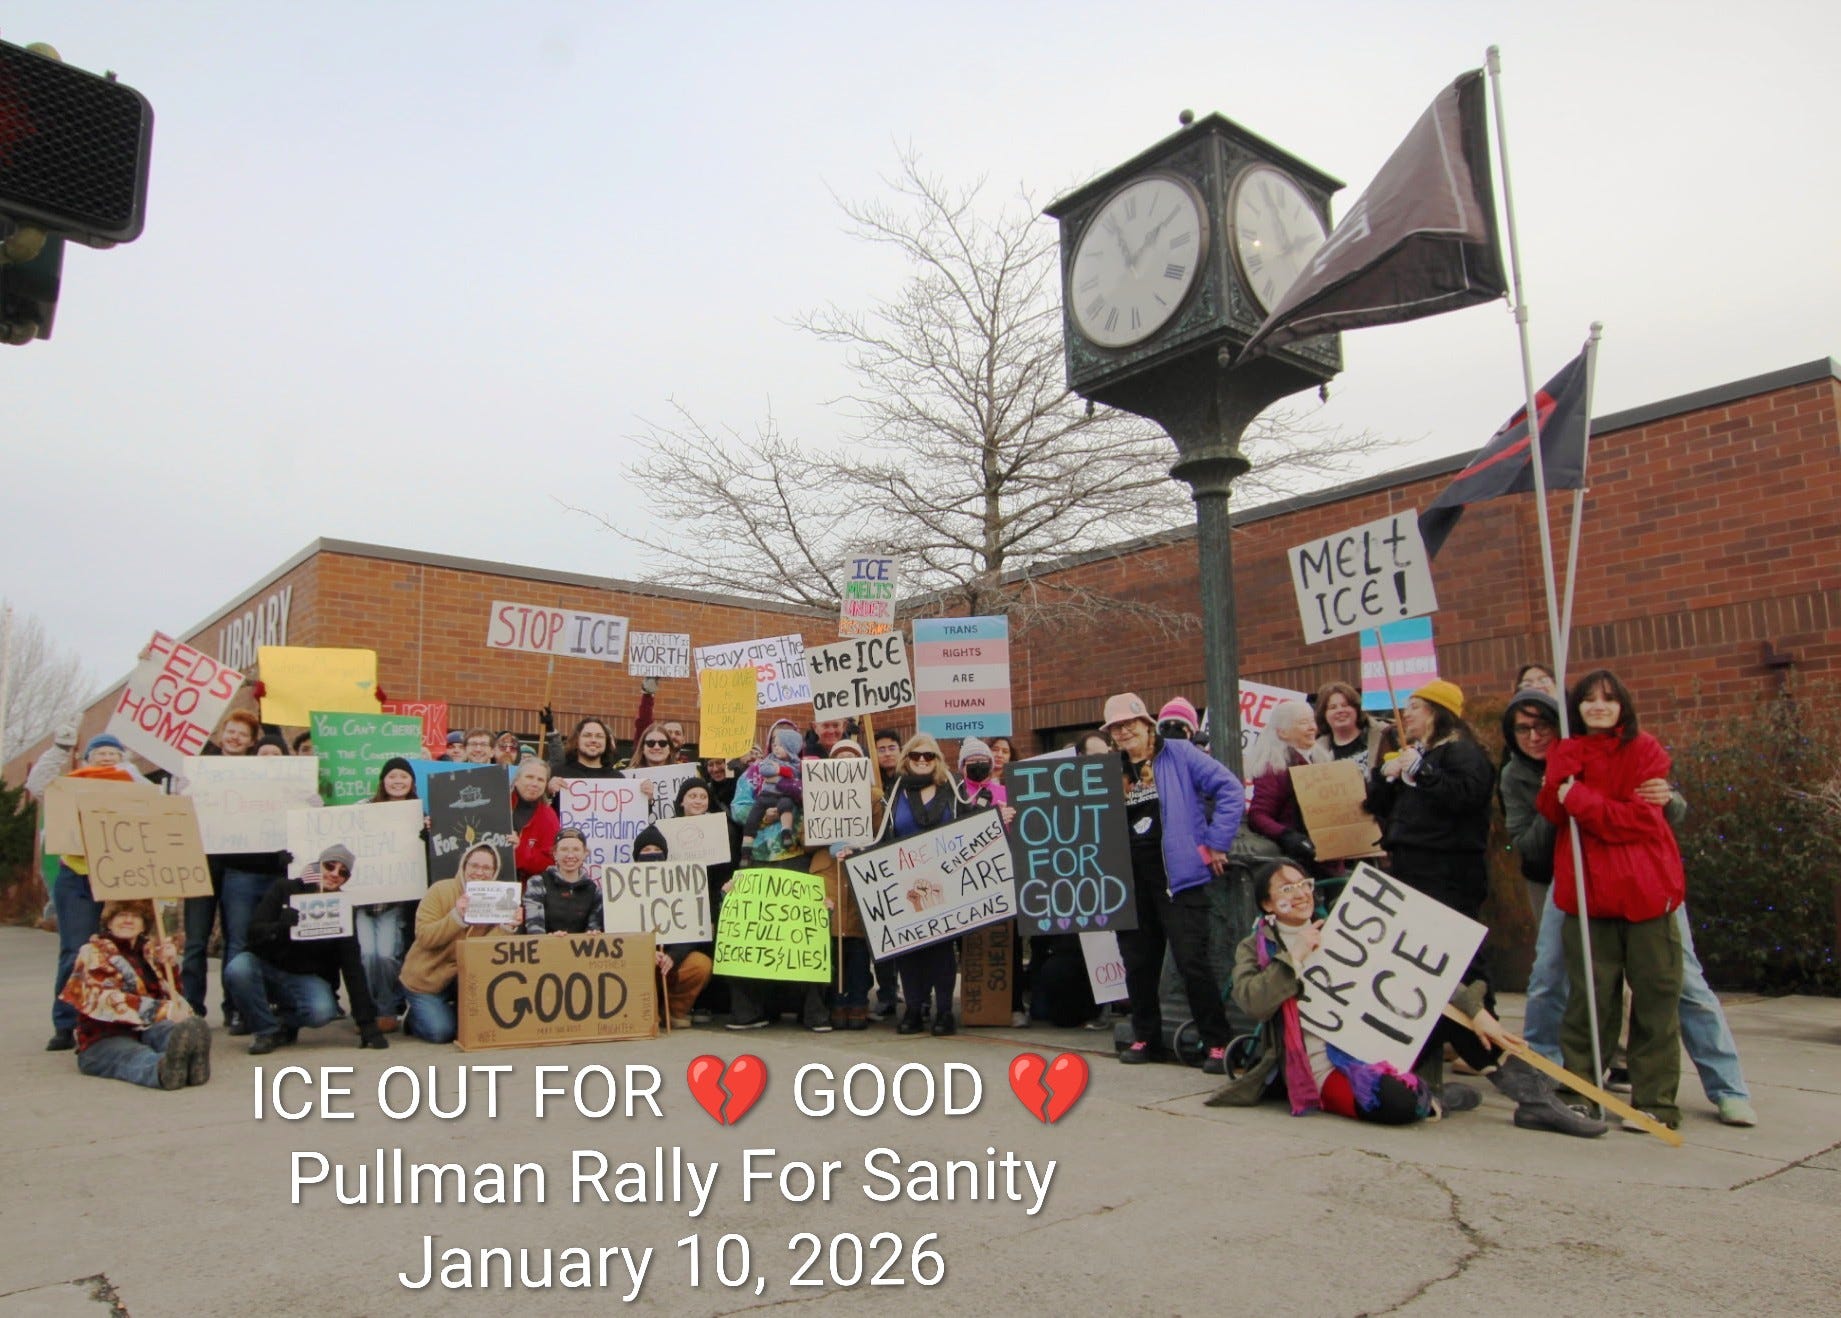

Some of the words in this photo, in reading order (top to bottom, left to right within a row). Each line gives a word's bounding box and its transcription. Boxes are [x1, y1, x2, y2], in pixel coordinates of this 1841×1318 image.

[851, 558, 893, 581] ICE
[845, 580, 894, 600] MELTS
[1317, 570, 1409, 635] ICE!
[843, 600, 890, 618] UNDER
[217, 585, 292, 671] LIBRARY
[494, 605, 565, 651] STOP
[570, 614, 621, 656] ICE
[631, 633, 681, 647] DIGNITY
[943, 624, 978, 635] TRANS
[146, 630, 243, 701] FEDS
[629, 645, 688, 665] WORTH
[694, 647, 744, 670] Heavy
[748, 644, 778, 660] are
[809, 648, 851, 675] the
[855, 636, 901, 673] ICE
[942, 647, 982, 658] RIGHTS
[630, 663, 671, 677] FIGHTING
[673, 665, 690, 677] FOR
[952, 673, 975, 683] ARE
[150, 674, 201, 716] GO
[767, 681, 811, 703] Clown
[813, 689, 850, 711] are
[850, 677, 913, 709] Thugs
[944, 698, 986, 709] HUMAN
[117, 688, 211, 757] HOME
[707, 703, 748, 716] ILLEGAL
[706, 724, 748, 739] STOLEN
[945, 720, 985, 731] RIGHTS
[805, 760, 870, 784] KNOW
[1013, 762, 1109, 802] ICE
[809, 788, 862, 811] YOUR
[100, 820, 157, 854] ICE
[808, 814, 870, 840] RIGHTS!
[1020, 803, 1109, 846] OUT
[432, 832, 460, 857] FOR
[613, 843, 632, 864] IS
[853, 859, 895, 885] WE
[897, 847, 930, 871] ARE
[940, 820, 1003, 875] ENEMIES
[96, 855, 206, 893] Gestapo
[1027, 843, 1104, 880] FOR
[605, 862, 707, 903] DEFUND
[766, 874, 824, 902] NOEMS
[862, 882, 905, 923] WE
[960, 852, 1015, 897] ARE
[1019, 875, 1127, 918] GOOD
[639, 896, 705, 937] ICE!
[758, 901, 777, 922] IS
[778, 904, 801, 922] SO
[803, 905, 829, 929] BIG
[880, 894, 1009, 953] AMERICANS
[717, 919, 741, 938] ITS
[744, 921, 785, 941] FULL
[790, 926, 818, 945] OF
[490, 939, 541, 965] SHE
[569, 937, 625, 959] WAS
[715, 941, 776, 968] SECRETS
[787, 944, 828, 972] LIES!
[1298, 867, 1406, 1033] CRUSH
[486, 970, 629, 1030] GOOD.
[1360, 929, 1450, 1046] ICE
